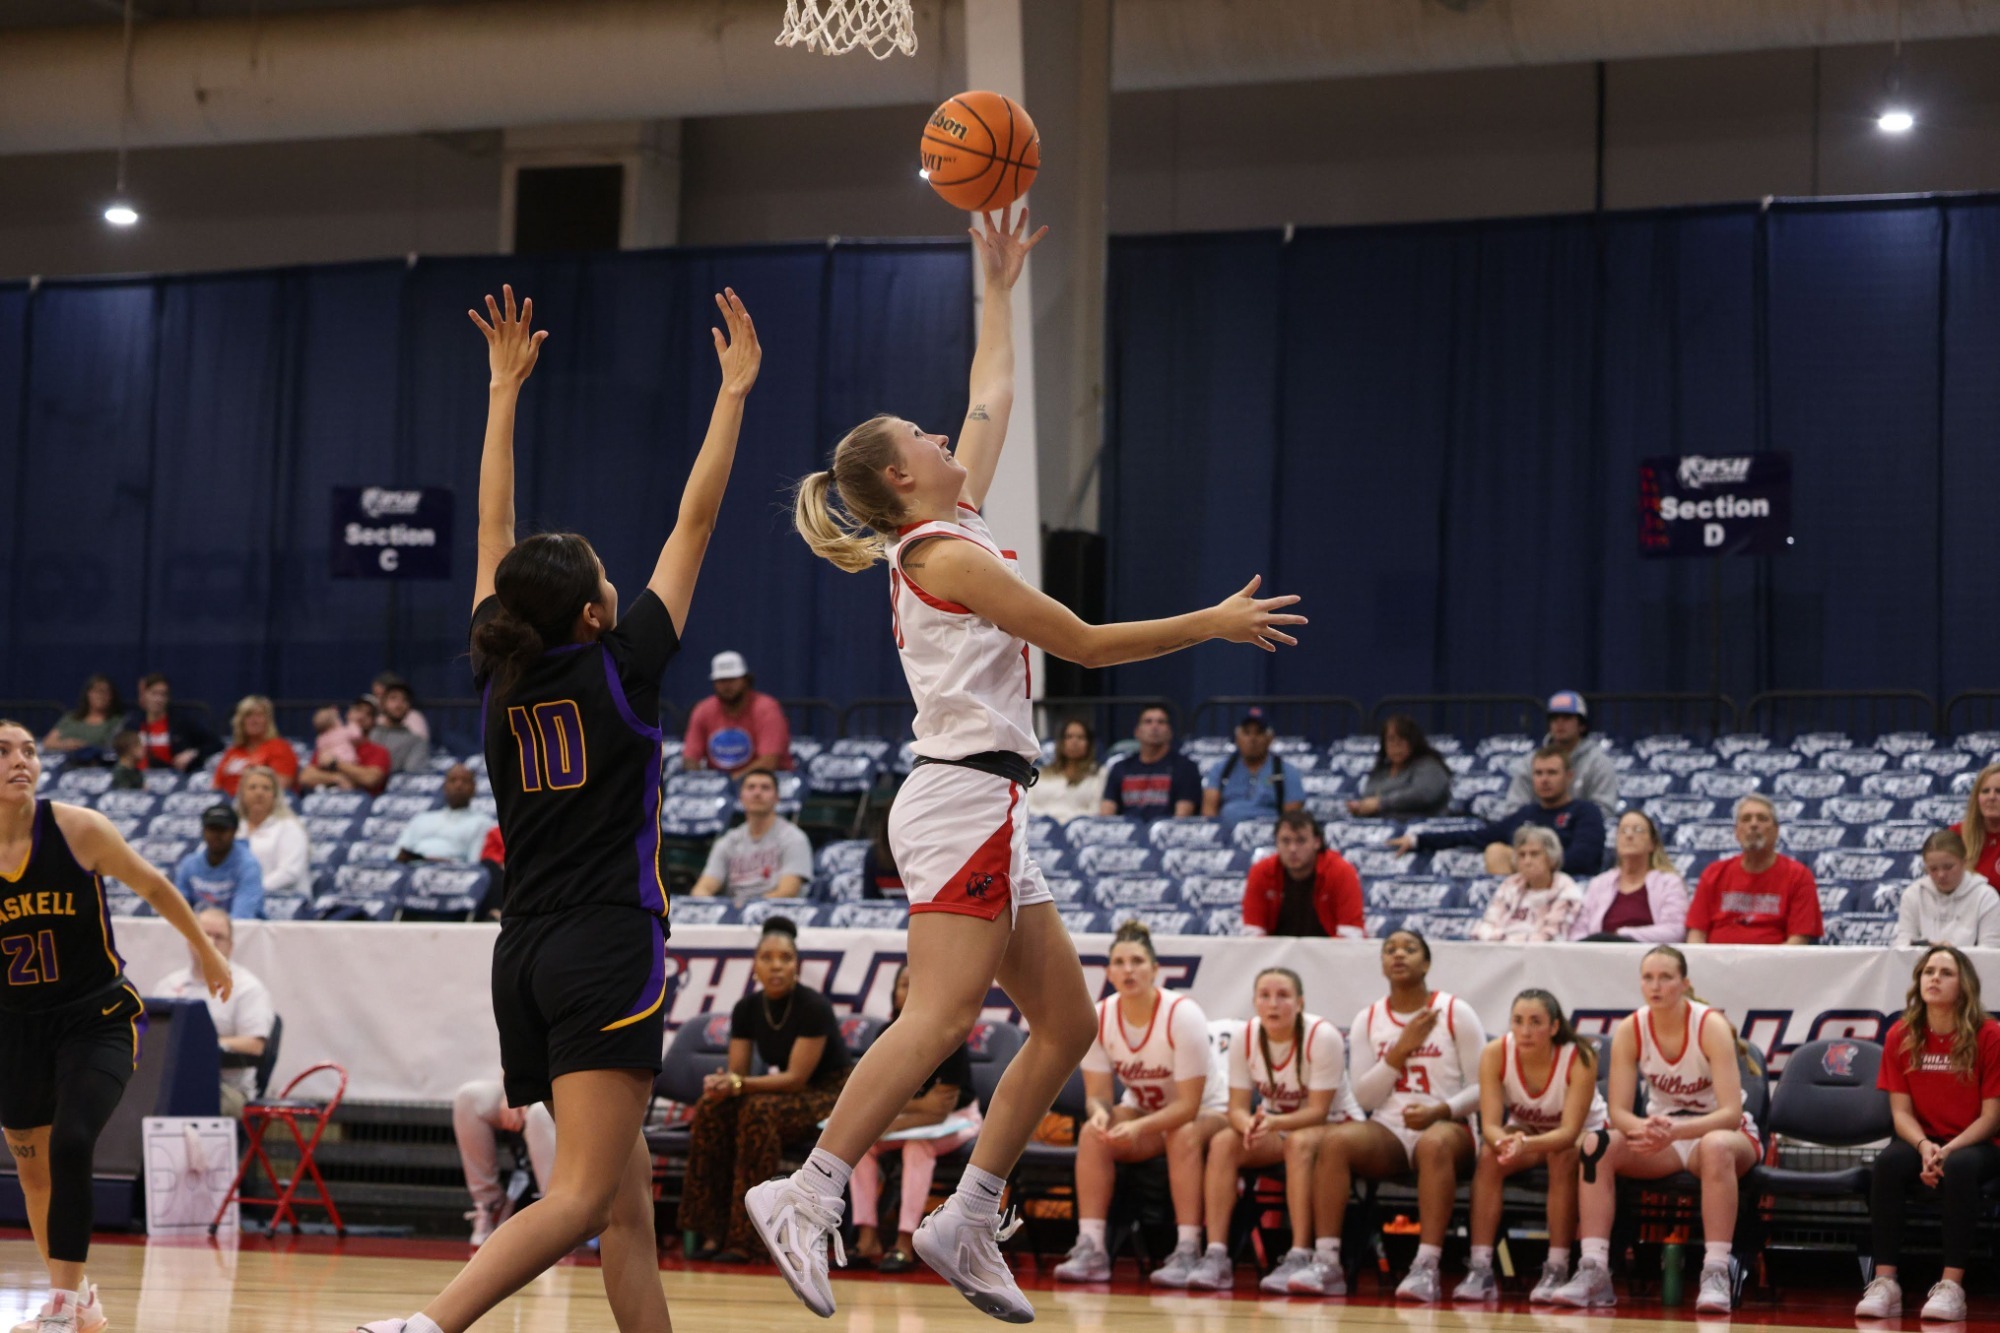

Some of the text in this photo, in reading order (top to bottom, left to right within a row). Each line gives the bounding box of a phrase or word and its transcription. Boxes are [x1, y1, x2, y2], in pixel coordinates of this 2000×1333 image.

[930, 106, 967, 141] lson
[1660, 494, 1769, 520] Section
[345, 522, 436, 546] Section
[1703, 523, 1725, 547] D
[378, 548, 399, 571] C
[507, 699, 587, 792] 10
[1, 929, 59, 985] 21
